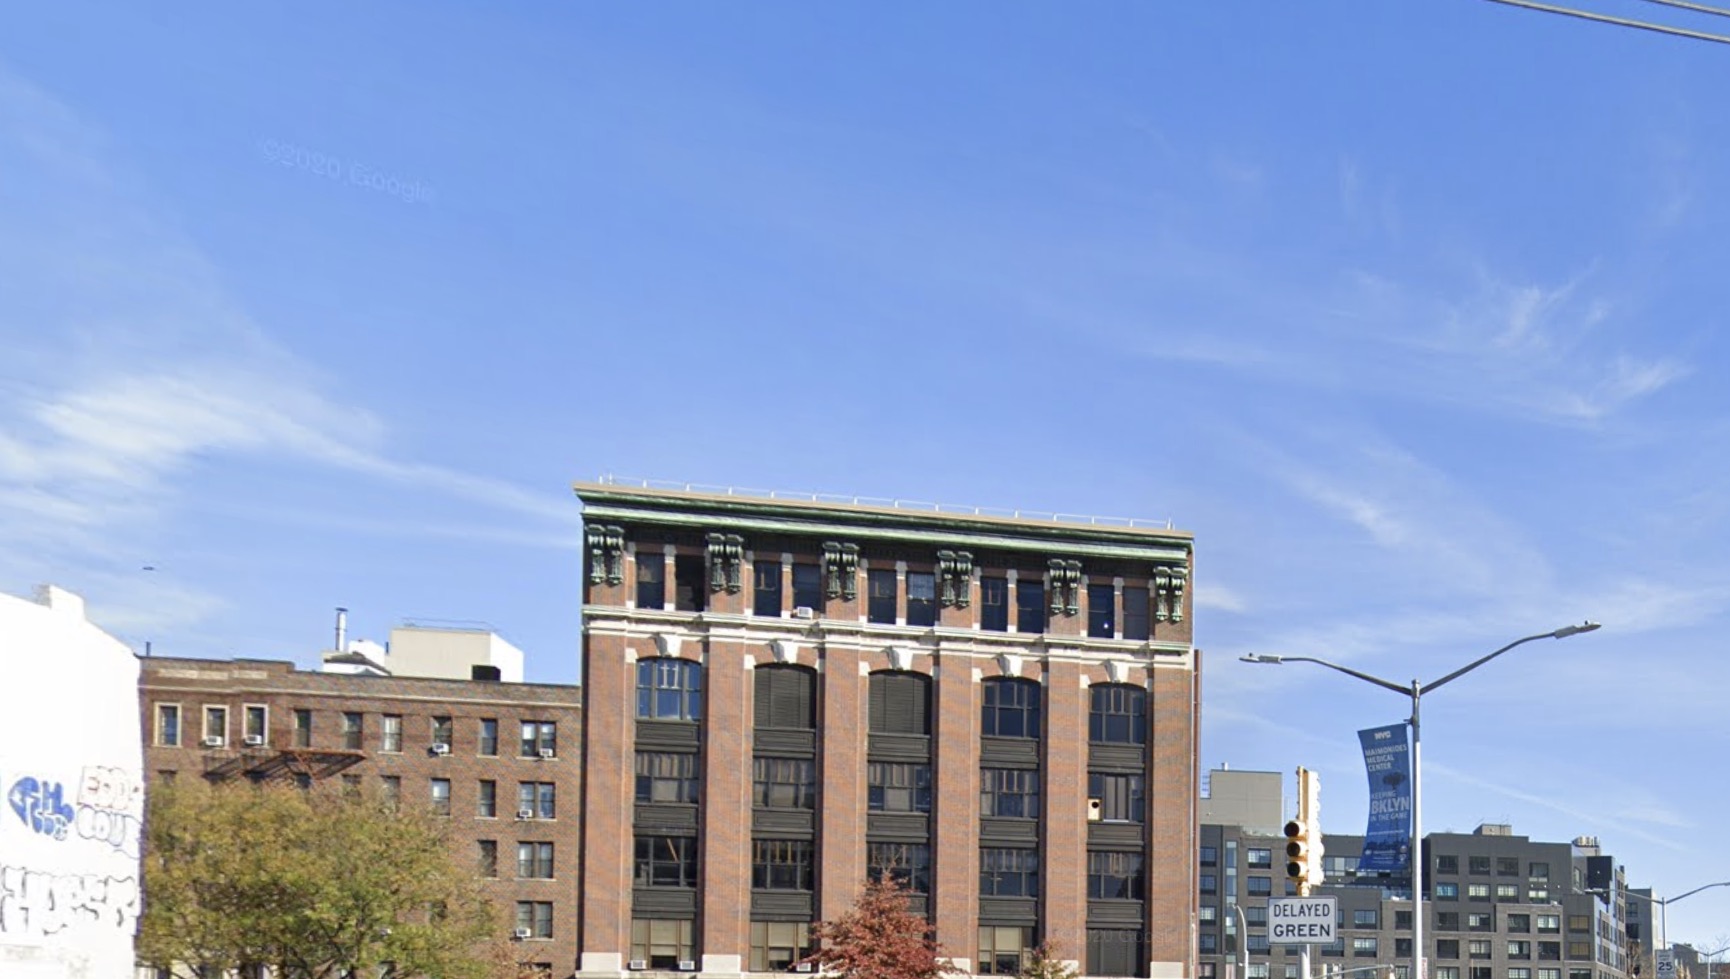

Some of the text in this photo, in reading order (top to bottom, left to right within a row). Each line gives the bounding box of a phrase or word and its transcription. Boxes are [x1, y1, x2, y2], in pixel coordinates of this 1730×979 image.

[1366, 754, 1395, 764] MEDICAL
[1368, 762, 1392, 772] CENTER
[1371, 797, 1410, 815] BKLYN
[1273, 903, 1331, 918] DELAYED
[1273, 923, 1331, 938] GREEN
[1658, 961, 1673, 971] 25
